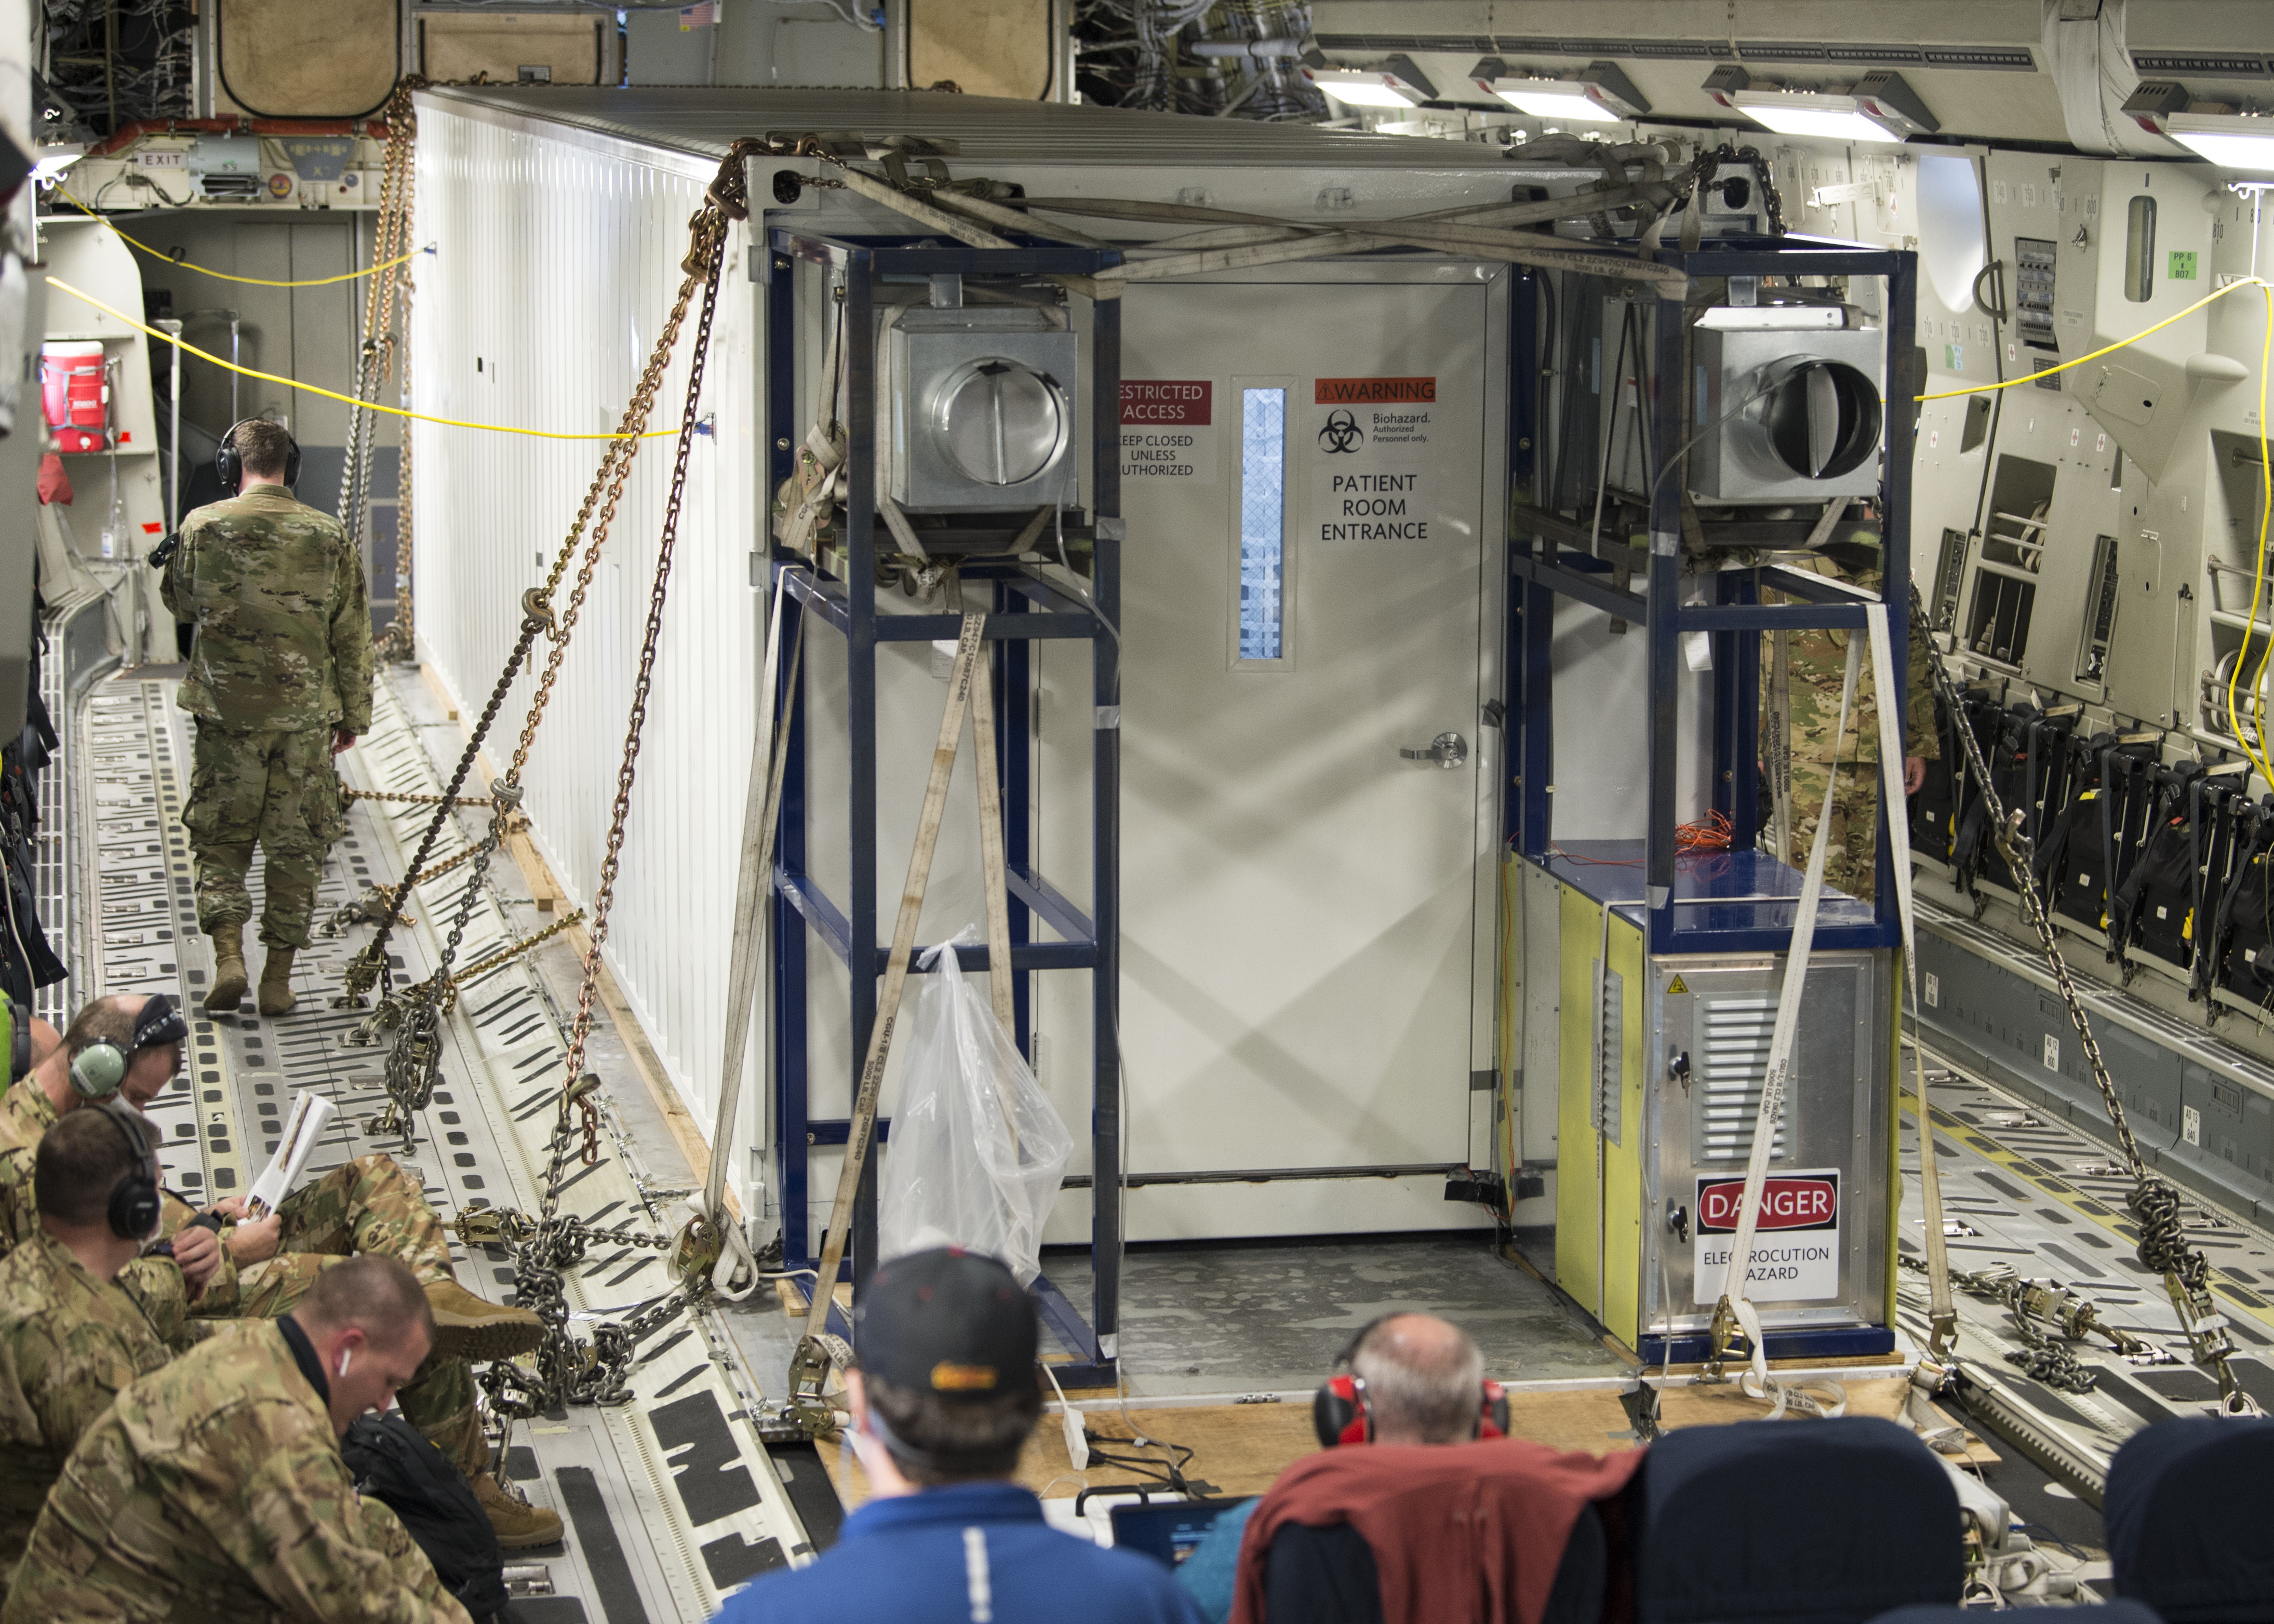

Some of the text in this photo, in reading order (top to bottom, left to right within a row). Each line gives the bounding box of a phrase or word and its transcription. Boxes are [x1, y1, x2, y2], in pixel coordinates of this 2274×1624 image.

[145, 155, 181, 166] EXIT
[2086, 199, 2096, 214] 800
[2250, 208, 2261, 223] 80
[2213, 223, 2223, 239] 810
[2175, 270, 2189, 278] 807
[1120, 385, 1203, 400] ESTRICTED
[1334, 382, 1435, 400] WARNING
[1123, 405, 1185, 419] ACCESS
[1373, 412, 1431, 424] Biohazard.
[1145, 435, 1193, 447] CLOSED
[1411, 434, 1429, 444] only.
[1131, 450, 1176, 461] UNLESS
[1120, 464, 1194, 476] UTHORIZED
[1332, 475, 1417, 492] PATIENT
[1343, 499, 1407, 516] ROOM
[1321, 522, 1428, 541] ENTRANCE
[878, 1016, 893, 1053] CGU-1/B
[2046, 1037, 2057, 1051] AD 12
[874, 1055, 884, 1072] CL2
[2047, 1055, 2055, 1068] 800
[865, 1060, 875, 1080] 5000
[1768, 1069, 1776, 1086] 5000
[1776, 1058, 1787, 1087] CGU-1/B
[1762, 1100, 1770, 1115] CAP.
[2186, 1108, 2198, 1123] AD 13
[2187, 1129, 2196, 1143] 840
[1709, 1190, 1828, 1218] DANGER
[1704, 1247, 1829, 1265] ELEROCUTION
[1746, 1267, 1798, 1281] AZARD
[822, 1338, 844, 1366] 5000 LB.
